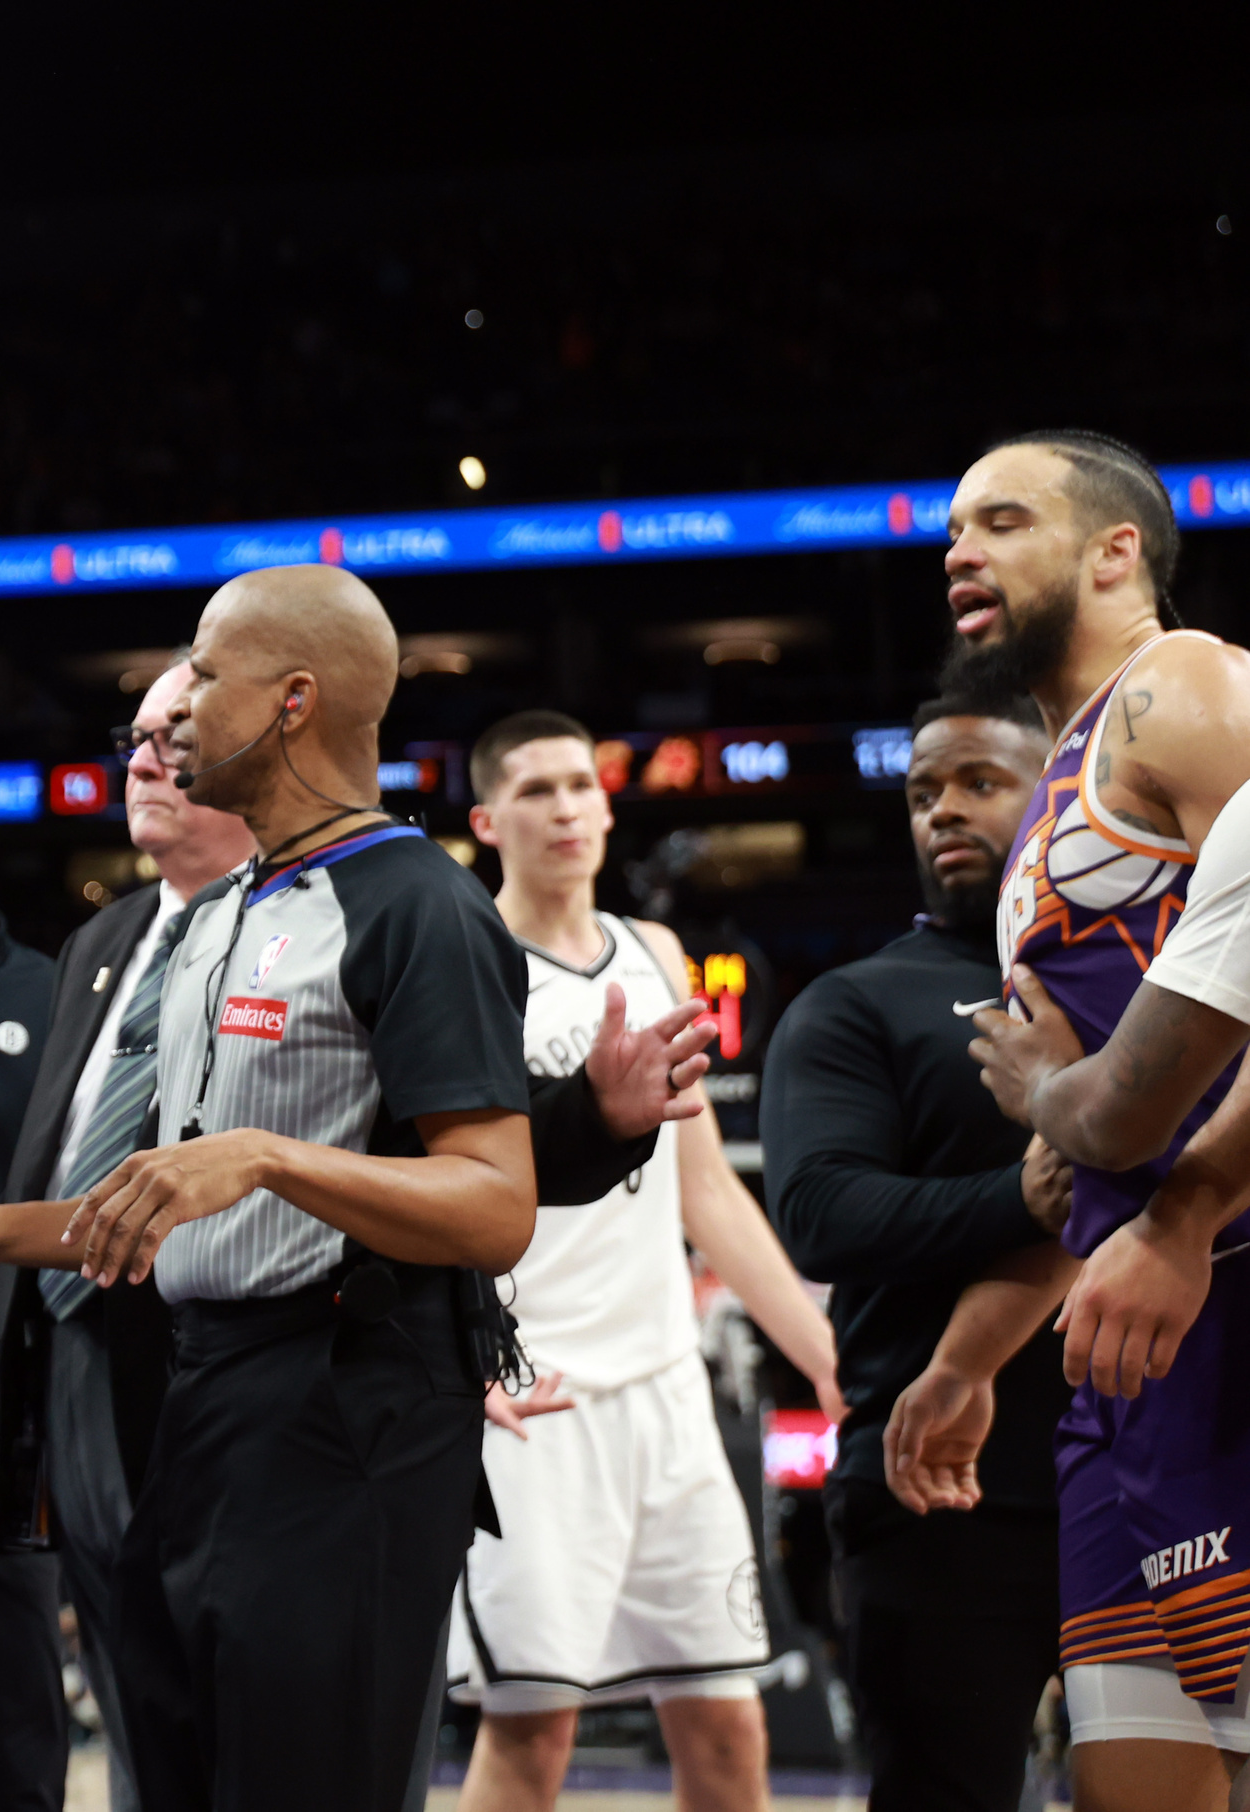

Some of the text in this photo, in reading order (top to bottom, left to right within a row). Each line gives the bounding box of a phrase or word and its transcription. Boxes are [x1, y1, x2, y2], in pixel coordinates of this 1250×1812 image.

[343, 527, 451, 565] ULTRA
[623, 511, 735, 549] ULTRA
[75, 544, 179, 581] ULTRA
[221, 1003, 285, 1031] Emirates
